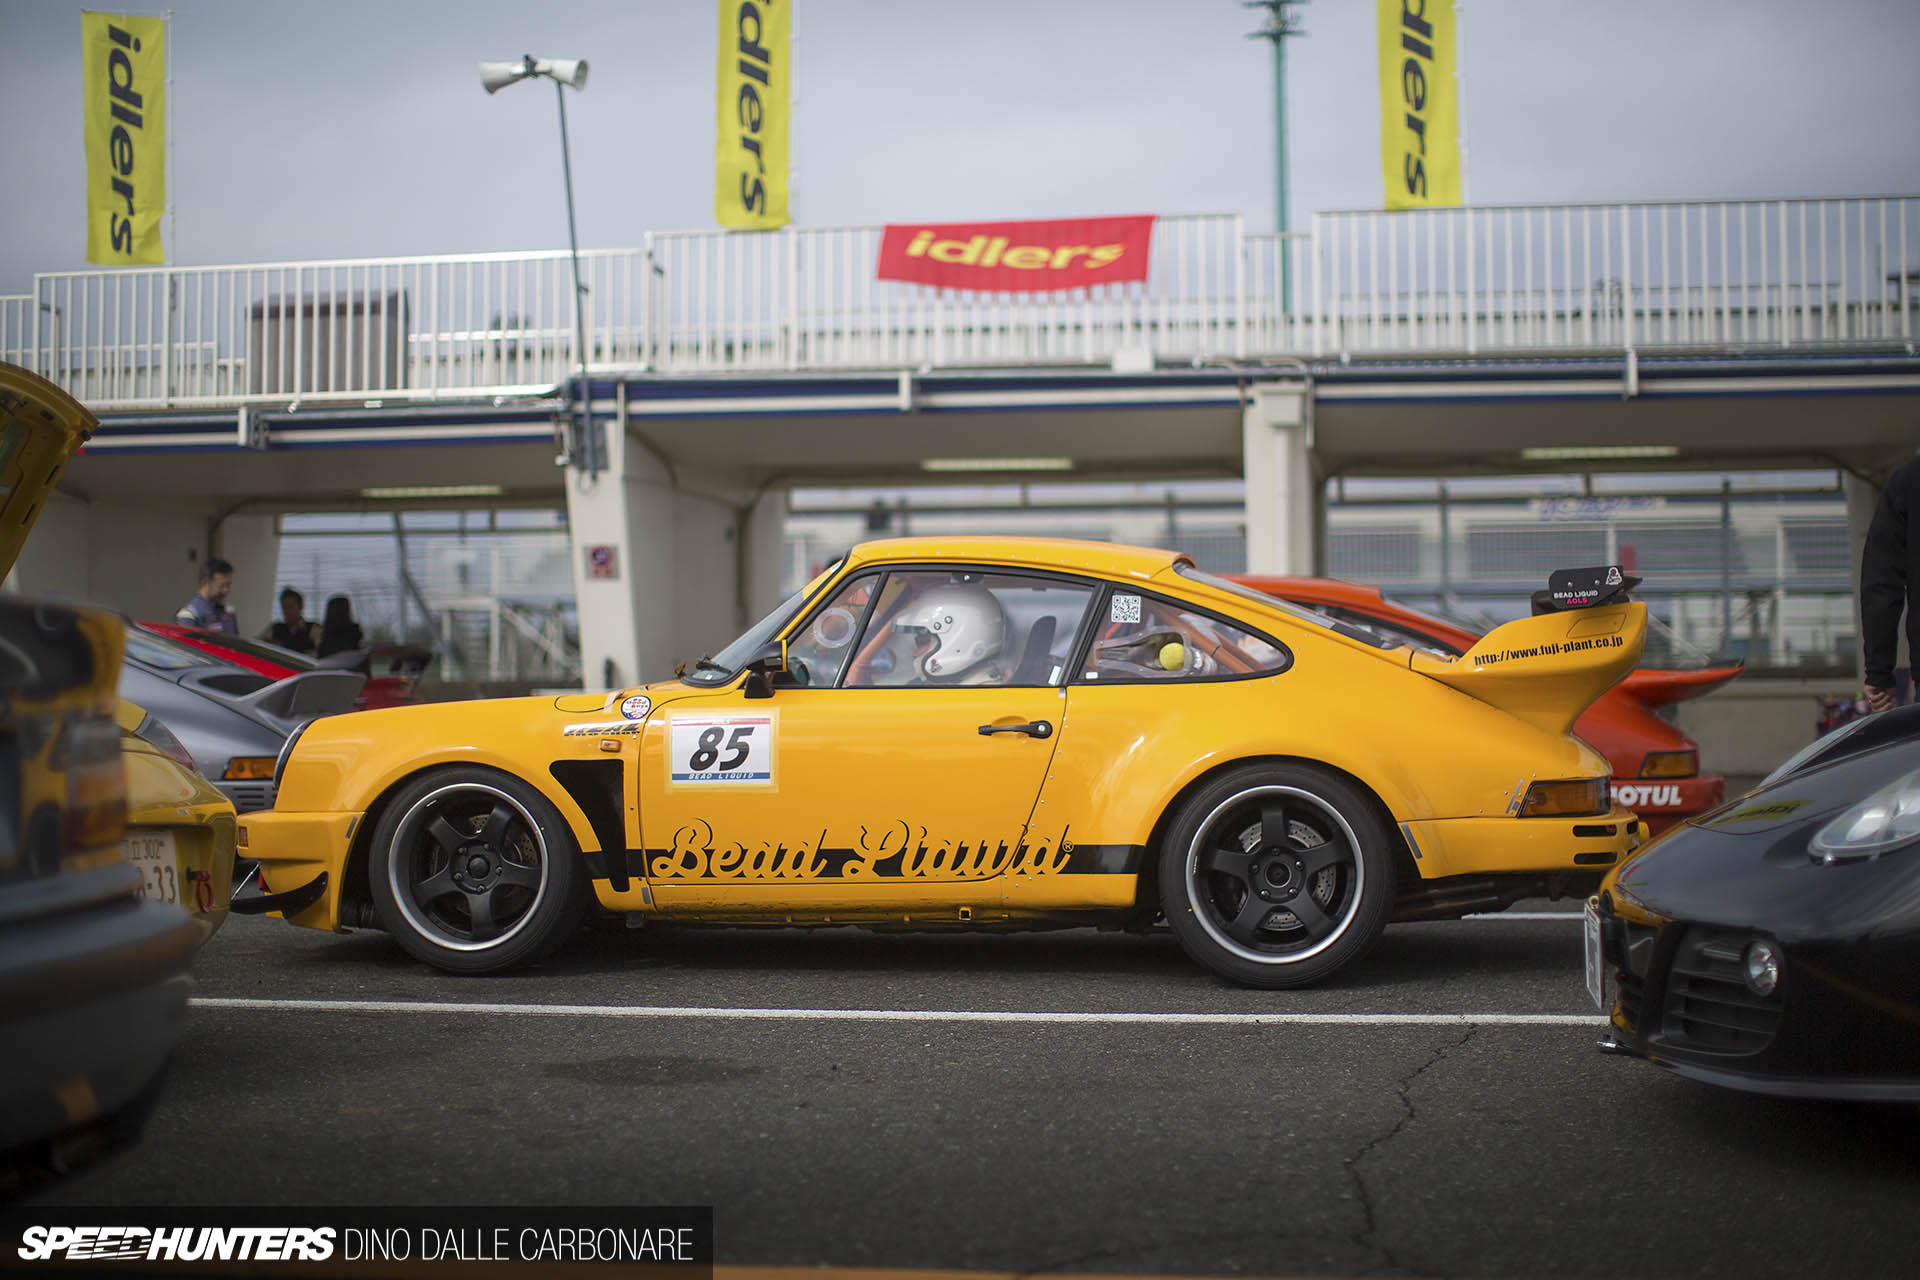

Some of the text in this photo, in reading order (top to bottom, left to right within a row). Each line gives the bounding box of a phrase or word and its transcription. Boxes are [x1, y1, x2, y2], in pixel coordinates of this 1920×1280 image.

[738, 0, 771, 216] dlers
[108, 24, 143, 256] idlers
[905, 230, 1124, 270] idlers
[1553, 590, 1599, 599] BEAD LIQUID
[1474, 635, 1623, 666] http://www.fuji-plant.co.jp
[689, 726, 755, 772] 85
[688, 772, 754, 780] BEAD LIQUID
[1610, 784, 1683, 807] OTUL
[651, 817, 829, 878] Bead
